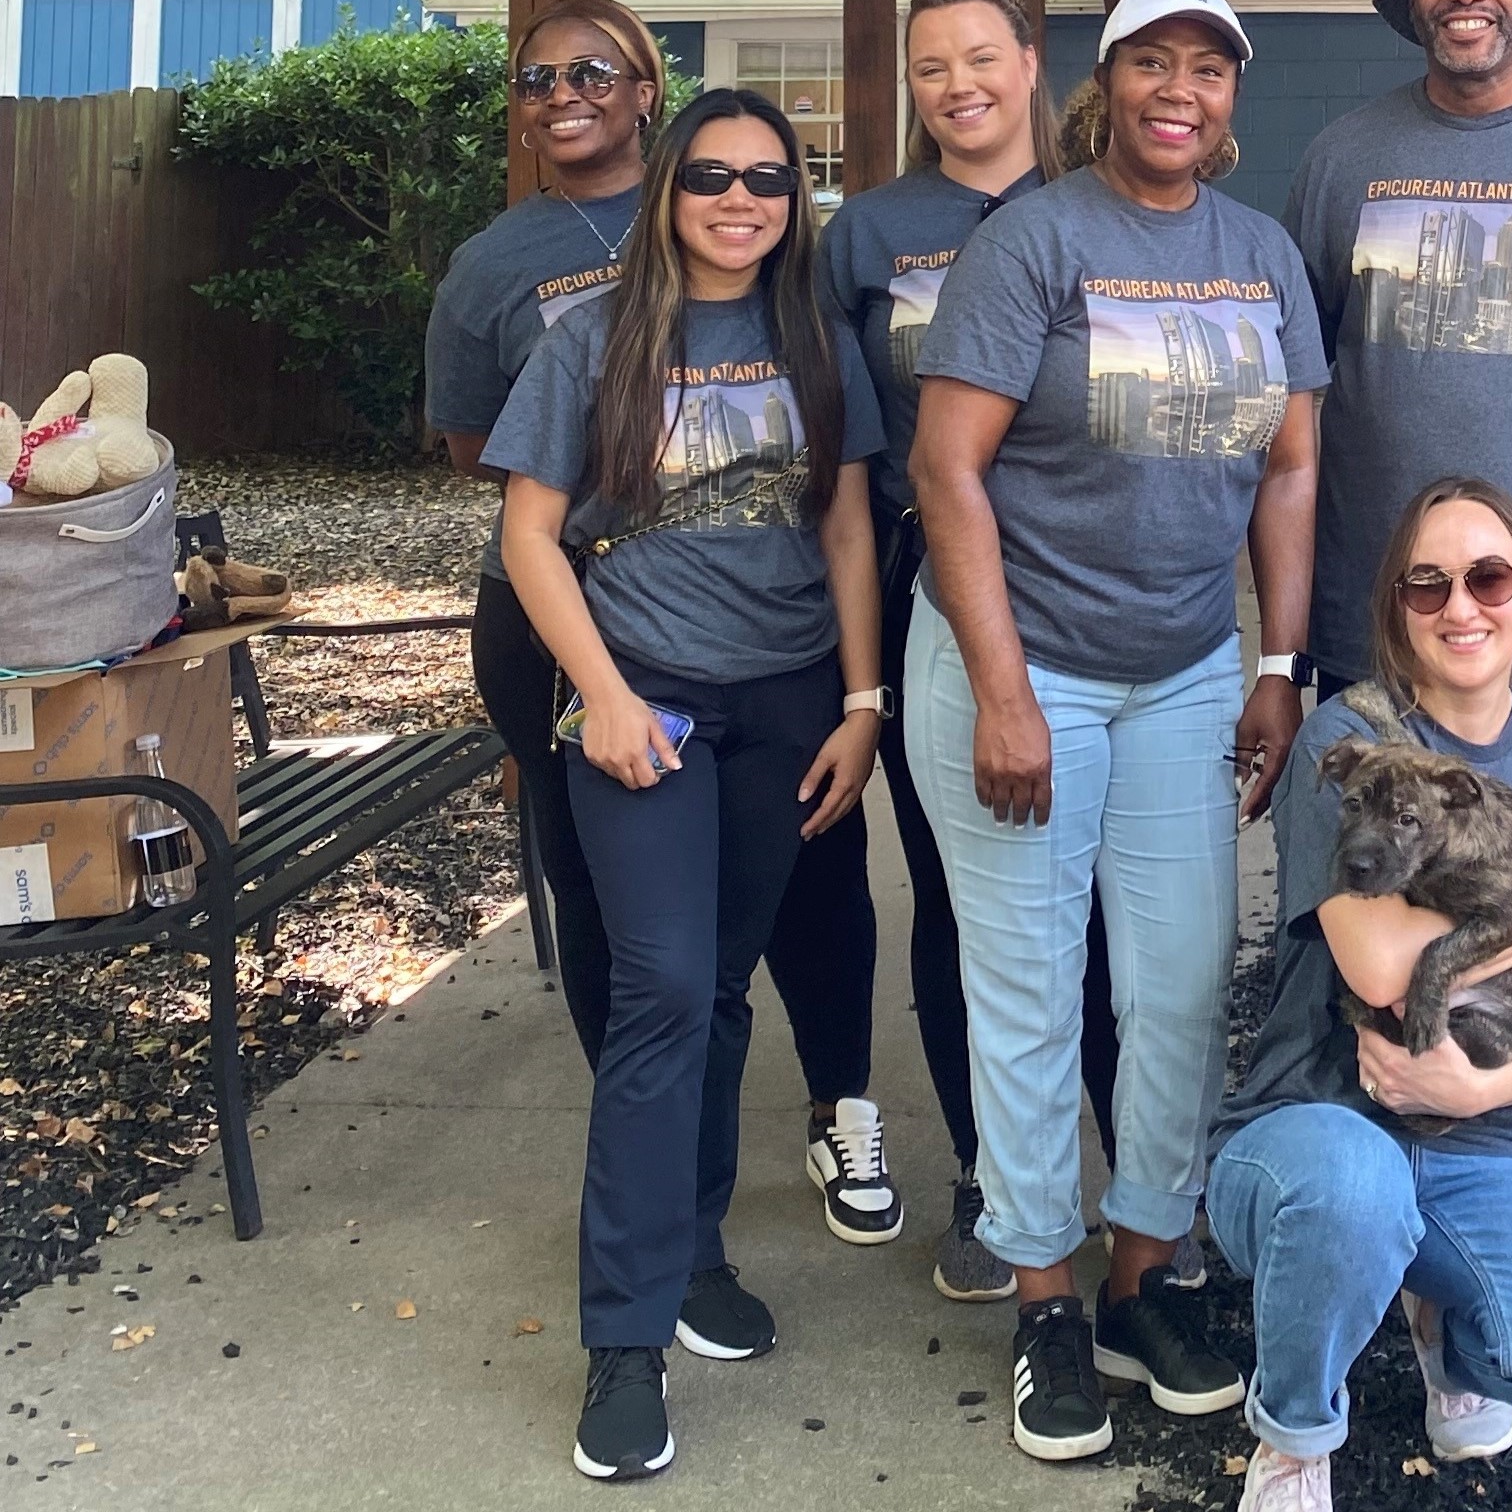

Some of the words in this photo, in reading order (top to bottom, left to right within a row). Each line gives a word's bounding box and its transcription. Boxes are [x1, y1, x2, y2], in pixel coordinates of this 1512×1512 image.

[1367, 179, 1455, 199] EPICUREAN
[1083, 279, 1173, 299] EPICUREAN
[1177, 278, 1242, 300] ATLANTA
[710, 361, 777, 382] ATLANTA
[15, 869, 32, 913] sam's
